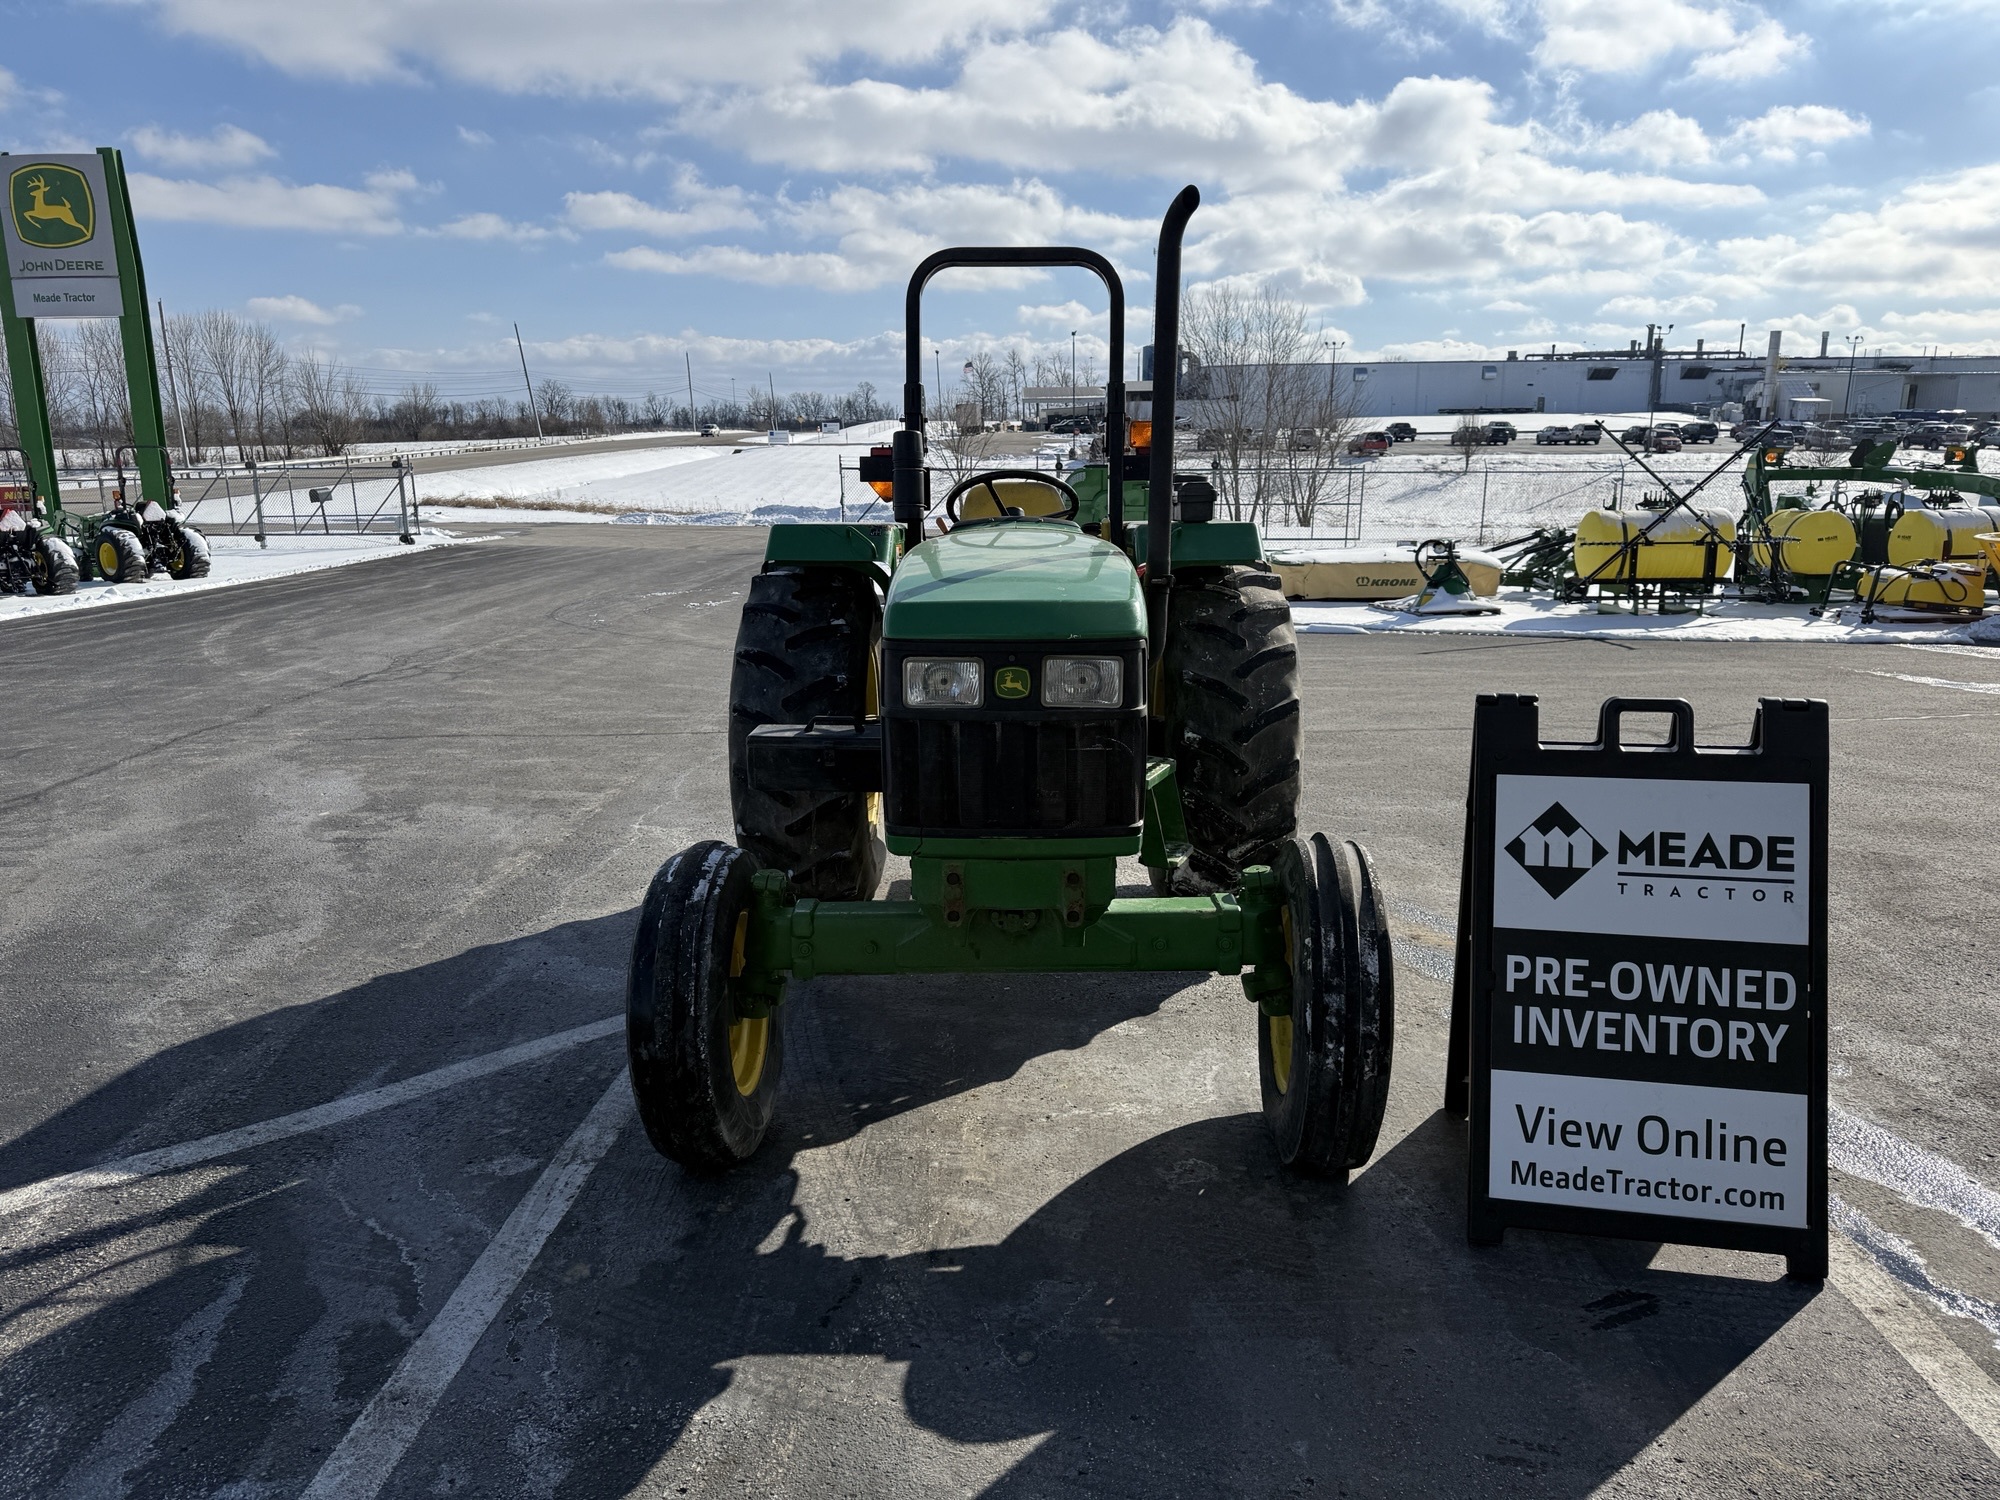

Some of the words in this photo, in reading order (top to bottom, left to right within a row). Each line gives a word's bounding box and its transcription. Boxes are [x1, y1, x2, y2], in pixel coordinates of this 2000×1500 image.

[19, 260, 53, 272] JOHN
[55, 259, 104, 271] DEERE
[33, 293, 61, 303] Meade
[63, 292, 95, 302] Tractor
[1371, 578, 1418, 587] KRONE
[1618, 829, 1795, 873] MEADE
[1617, 882, 1795, 903] TRACTOR
[1506, 954, 1797, 1011] PRE-OWNED
[1513, 1005, 1790, 1063] INVENTORY
[1515, 1104, 1623, 1151] View
[1637, 1115, 1787, 1167] Online
[1511, 1160, 1785, 1211] MeadeTractor.com
